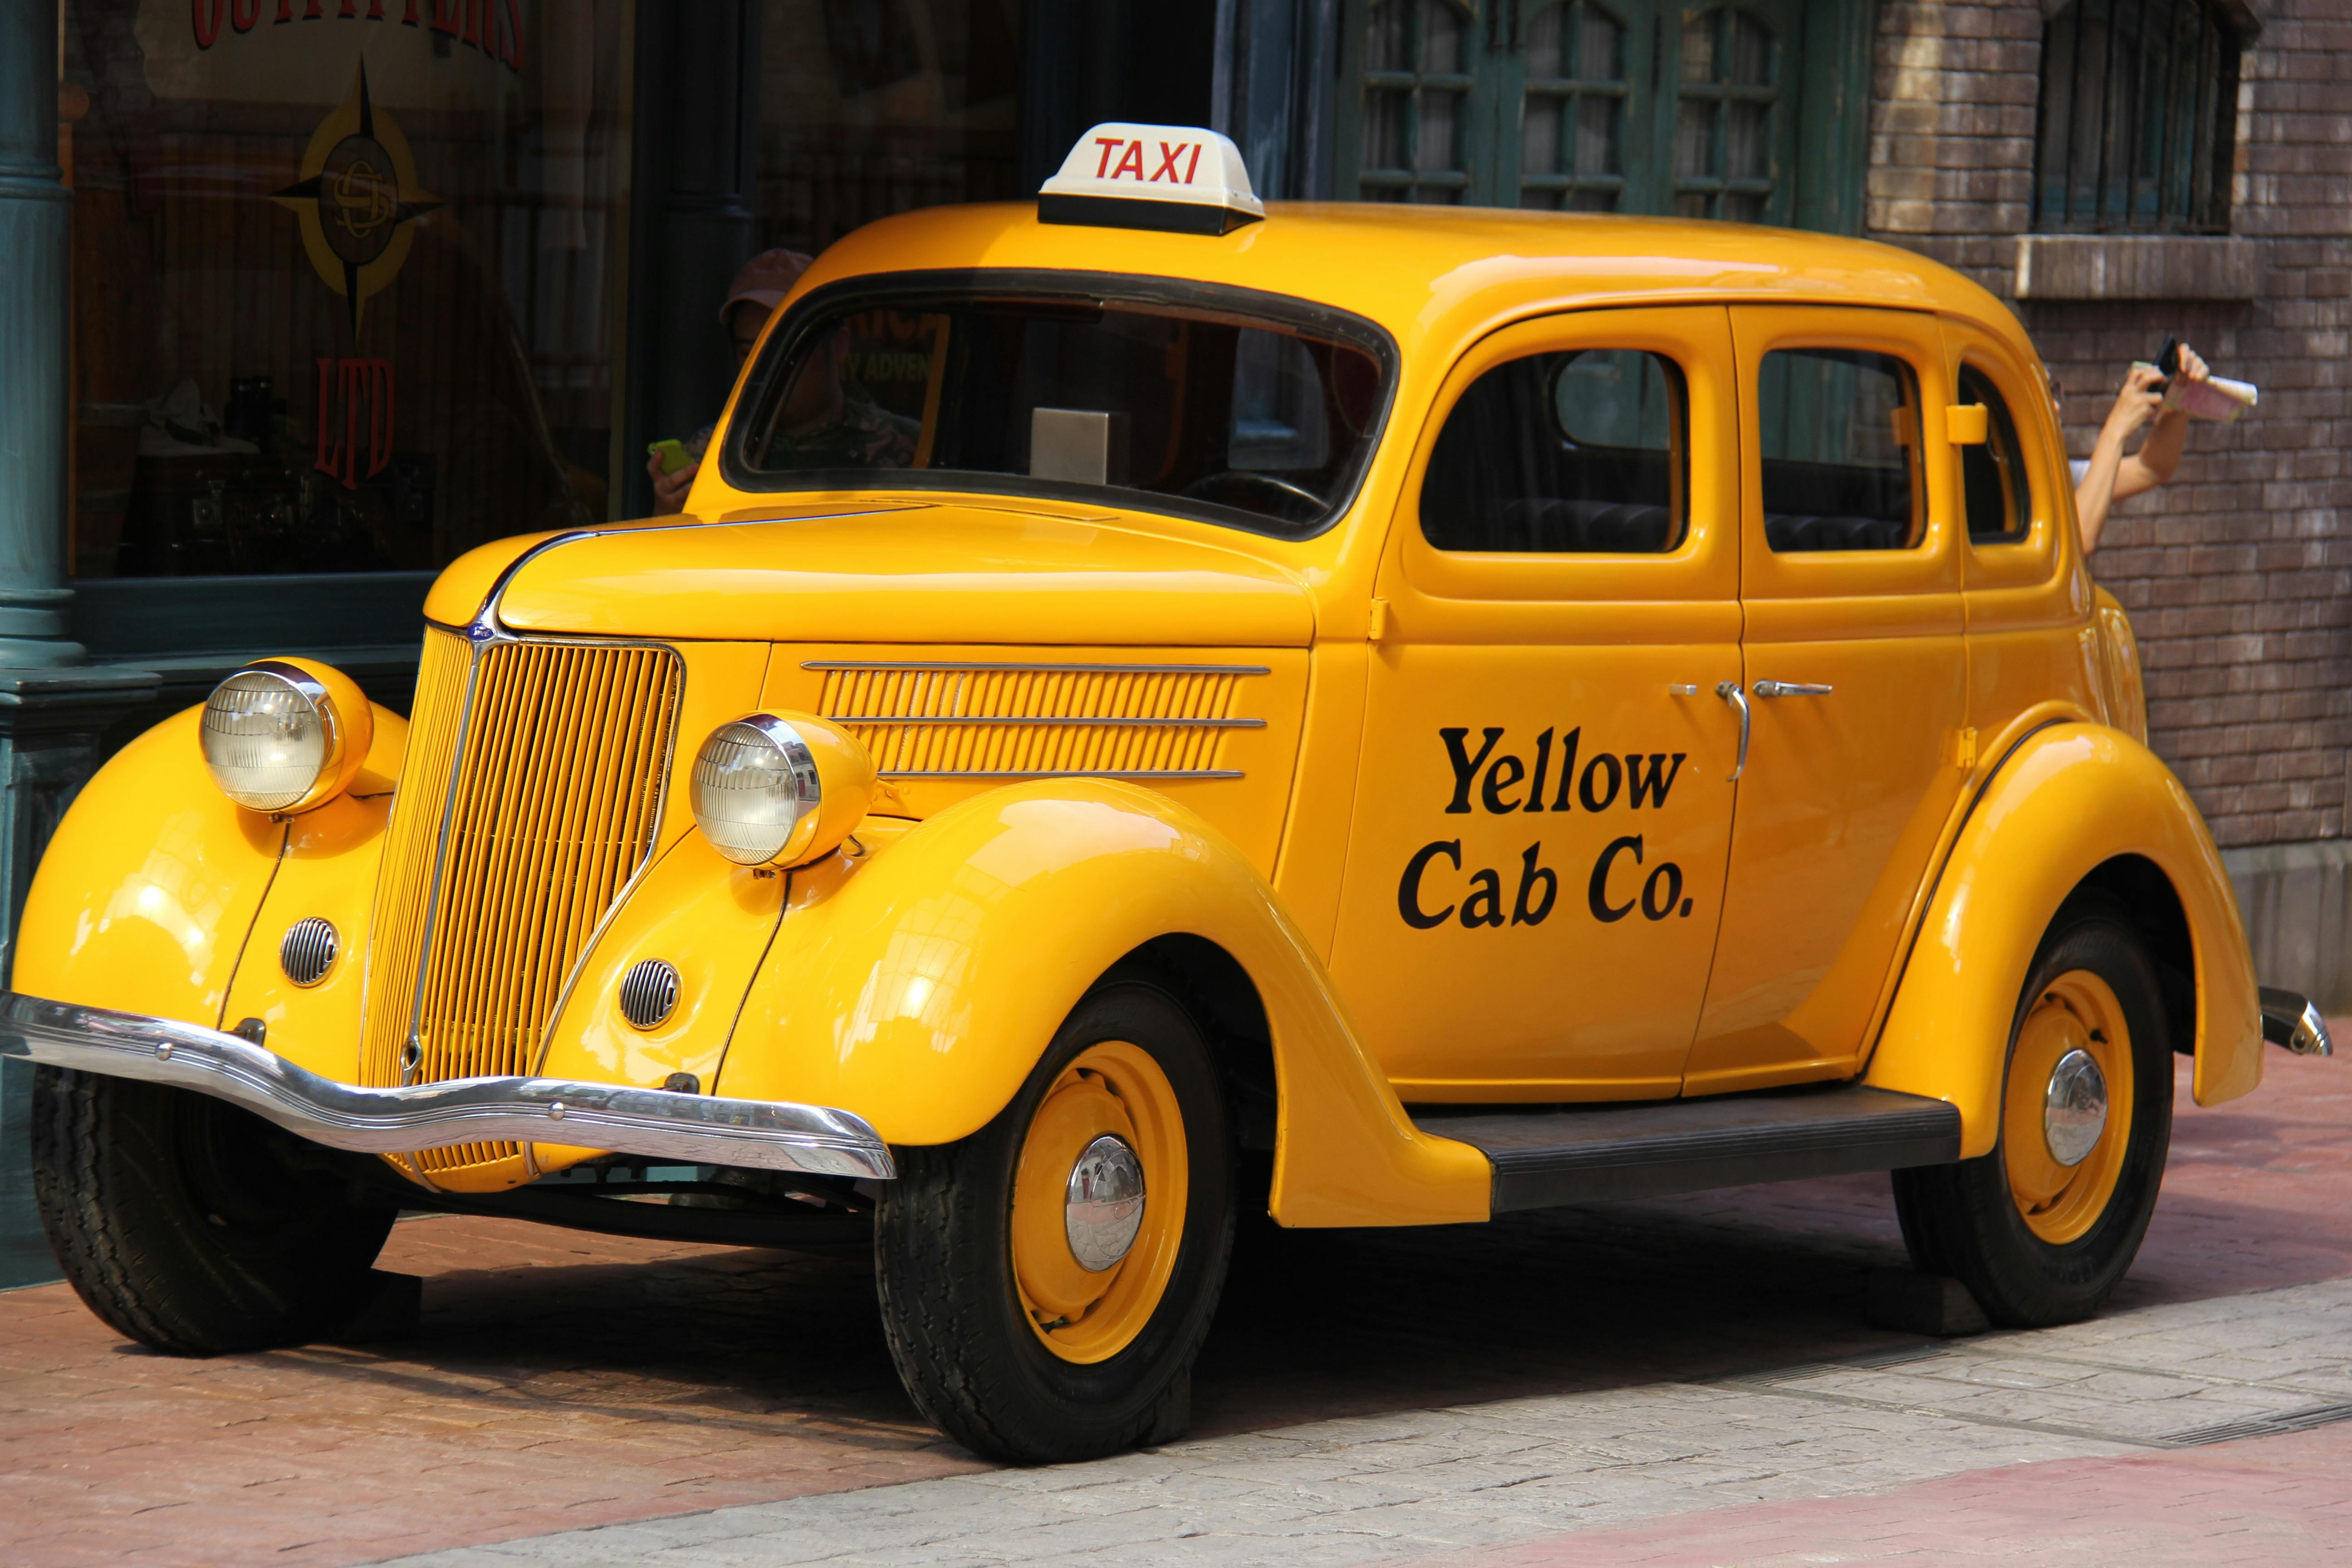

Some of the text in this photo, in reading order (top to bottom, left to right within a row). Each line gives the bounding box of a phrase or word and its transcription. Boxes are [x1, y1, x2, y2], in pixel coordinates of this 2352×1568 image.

[1095, 137, 1202, 184] TAXI
[313, 358, 396, 490] LTD
[1439, 726, 1687, 815] Yellow
[1397, 833, 1694, 930] Cab Co.
